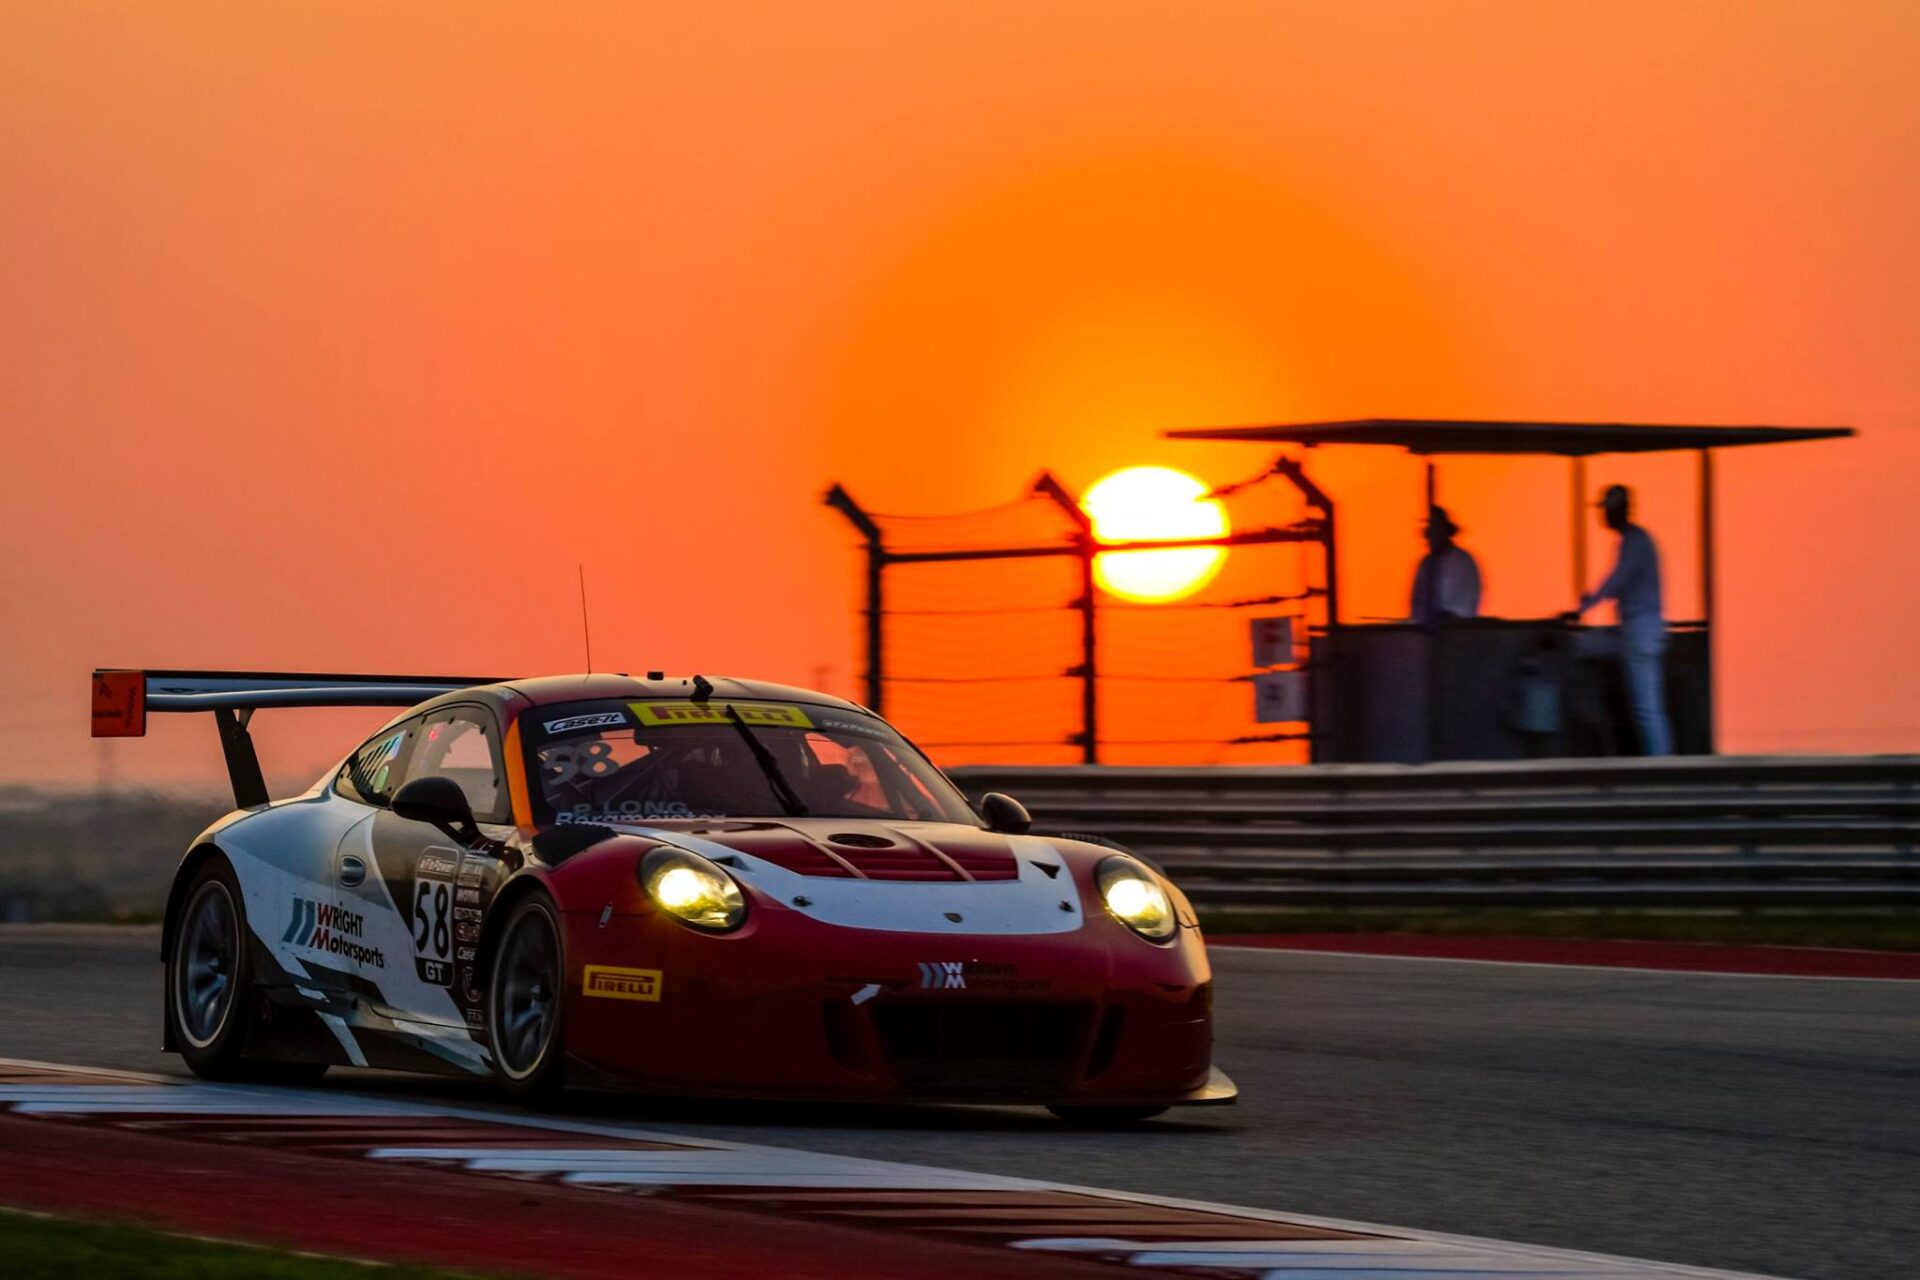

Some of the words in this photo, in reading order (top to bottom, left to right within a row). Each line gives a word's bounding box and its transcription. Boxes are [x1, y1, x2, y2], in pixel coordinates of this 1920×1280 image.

[602, 800, 690, 815] LONG
[415, 881, 449, 958] 58
[308, 927, 385, 968] Motorsports
[424, 962, 444, 983] GT
[589, 971, 655, 995] PIRELLI
